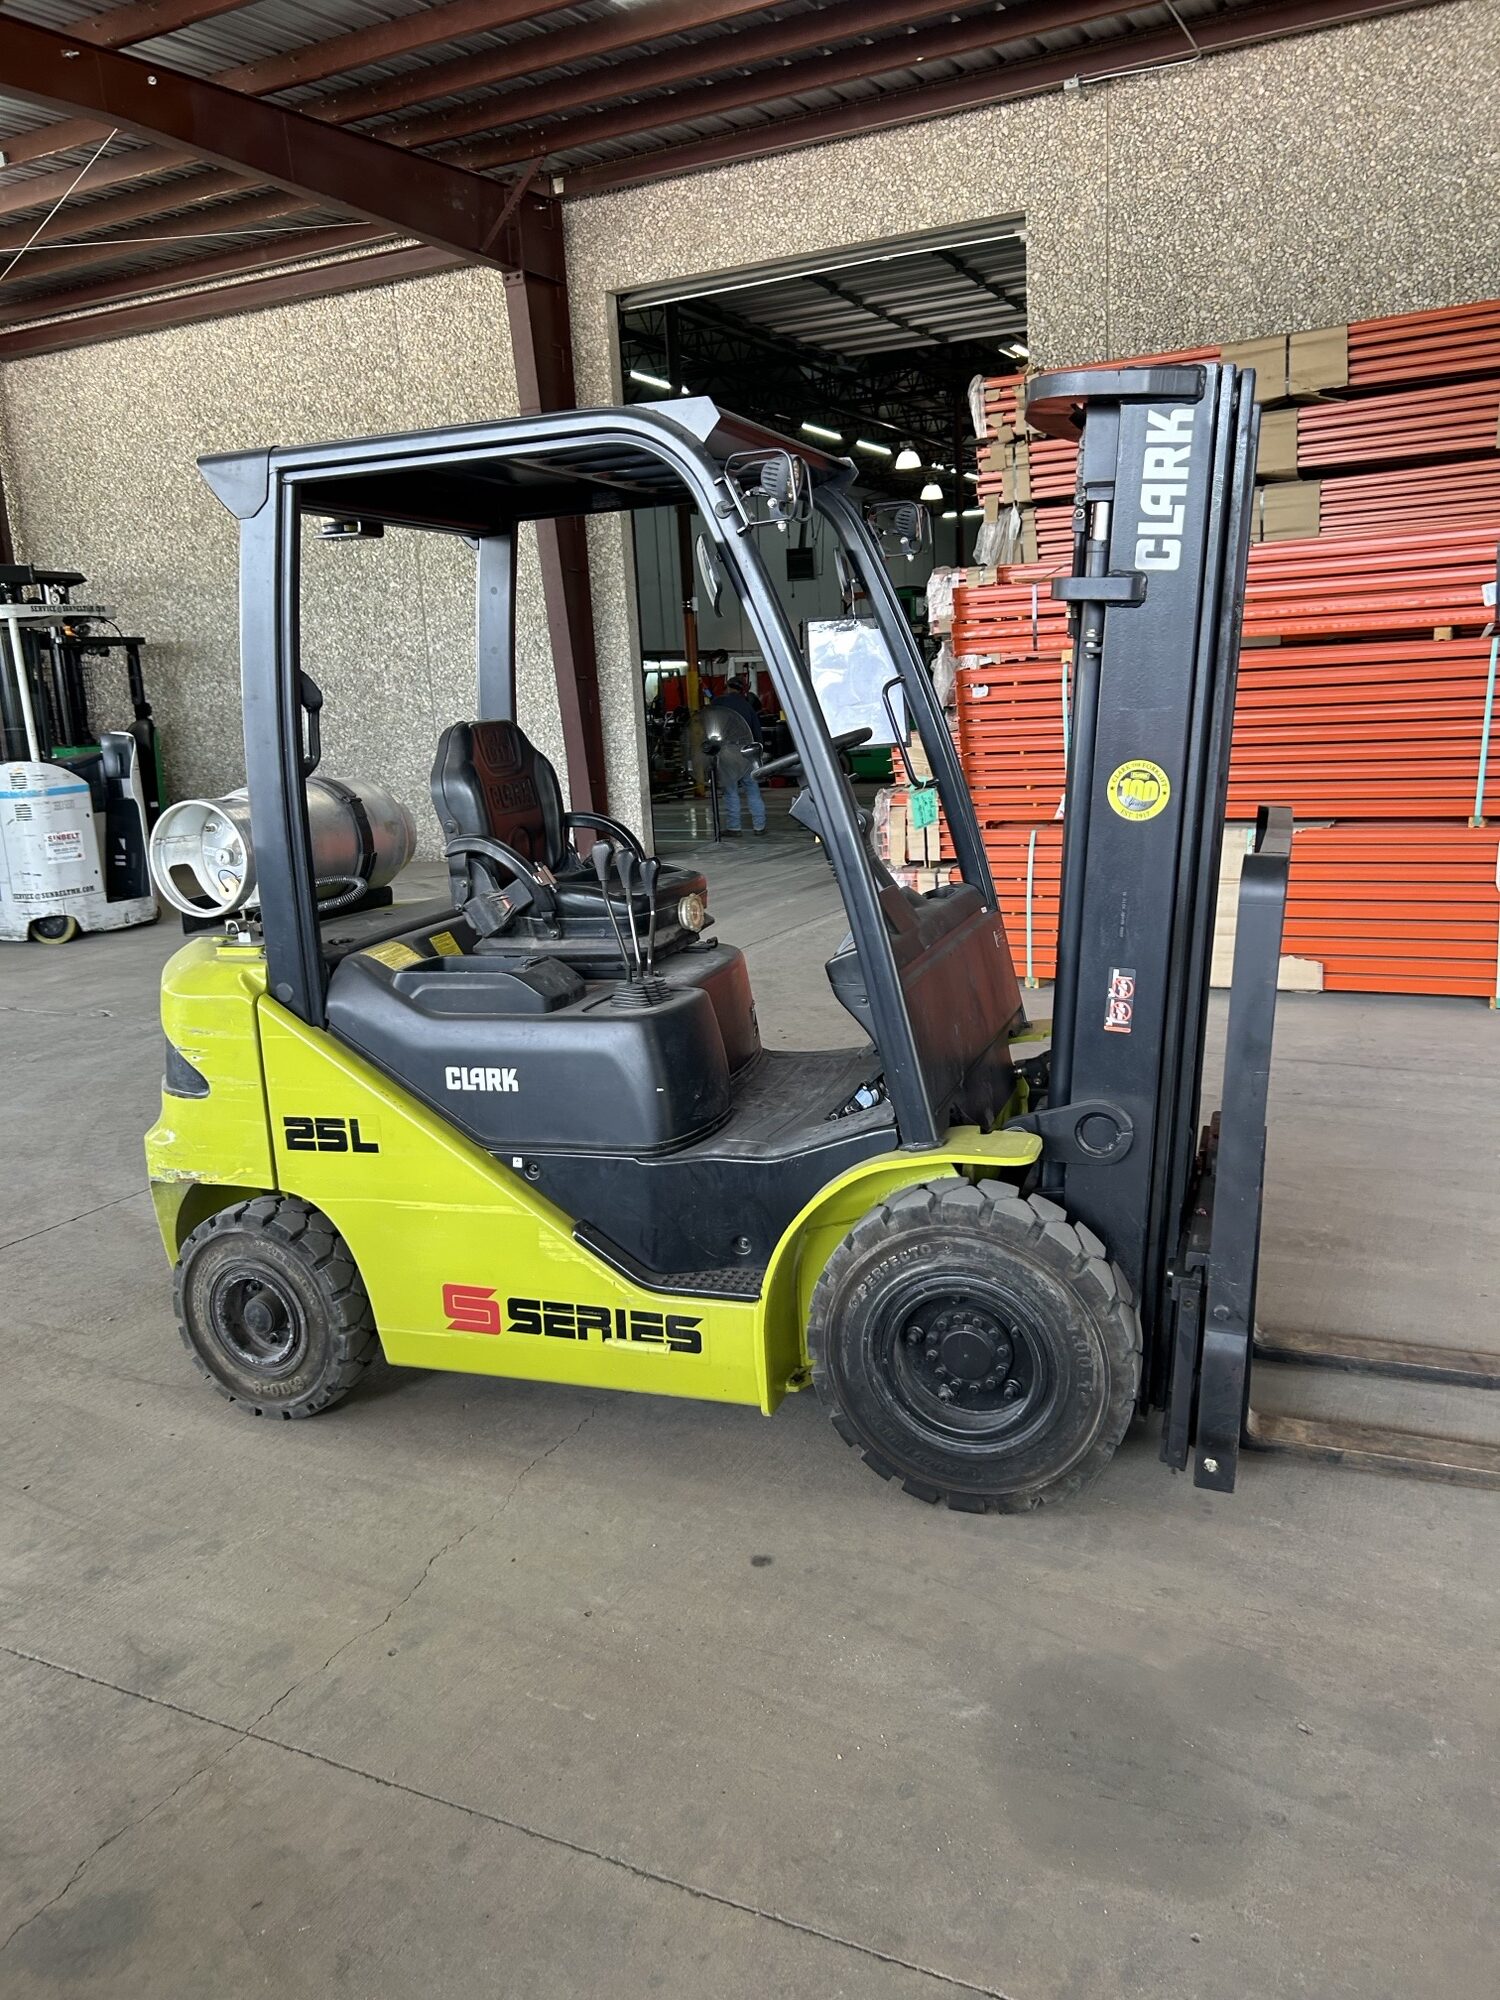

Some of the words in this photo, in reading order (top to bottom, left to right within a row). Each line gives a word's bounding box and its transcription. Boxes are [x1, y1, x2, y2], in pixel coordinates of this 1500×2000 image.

[1135, 409, 1194, 570] CLARK
[1120, 777, 1159, 802] 100
[445, 1066, 519, 1092] CLARK
[283, 1116, 380, 1153] 25L
[507, 1297, 704, 1354] SERIES
